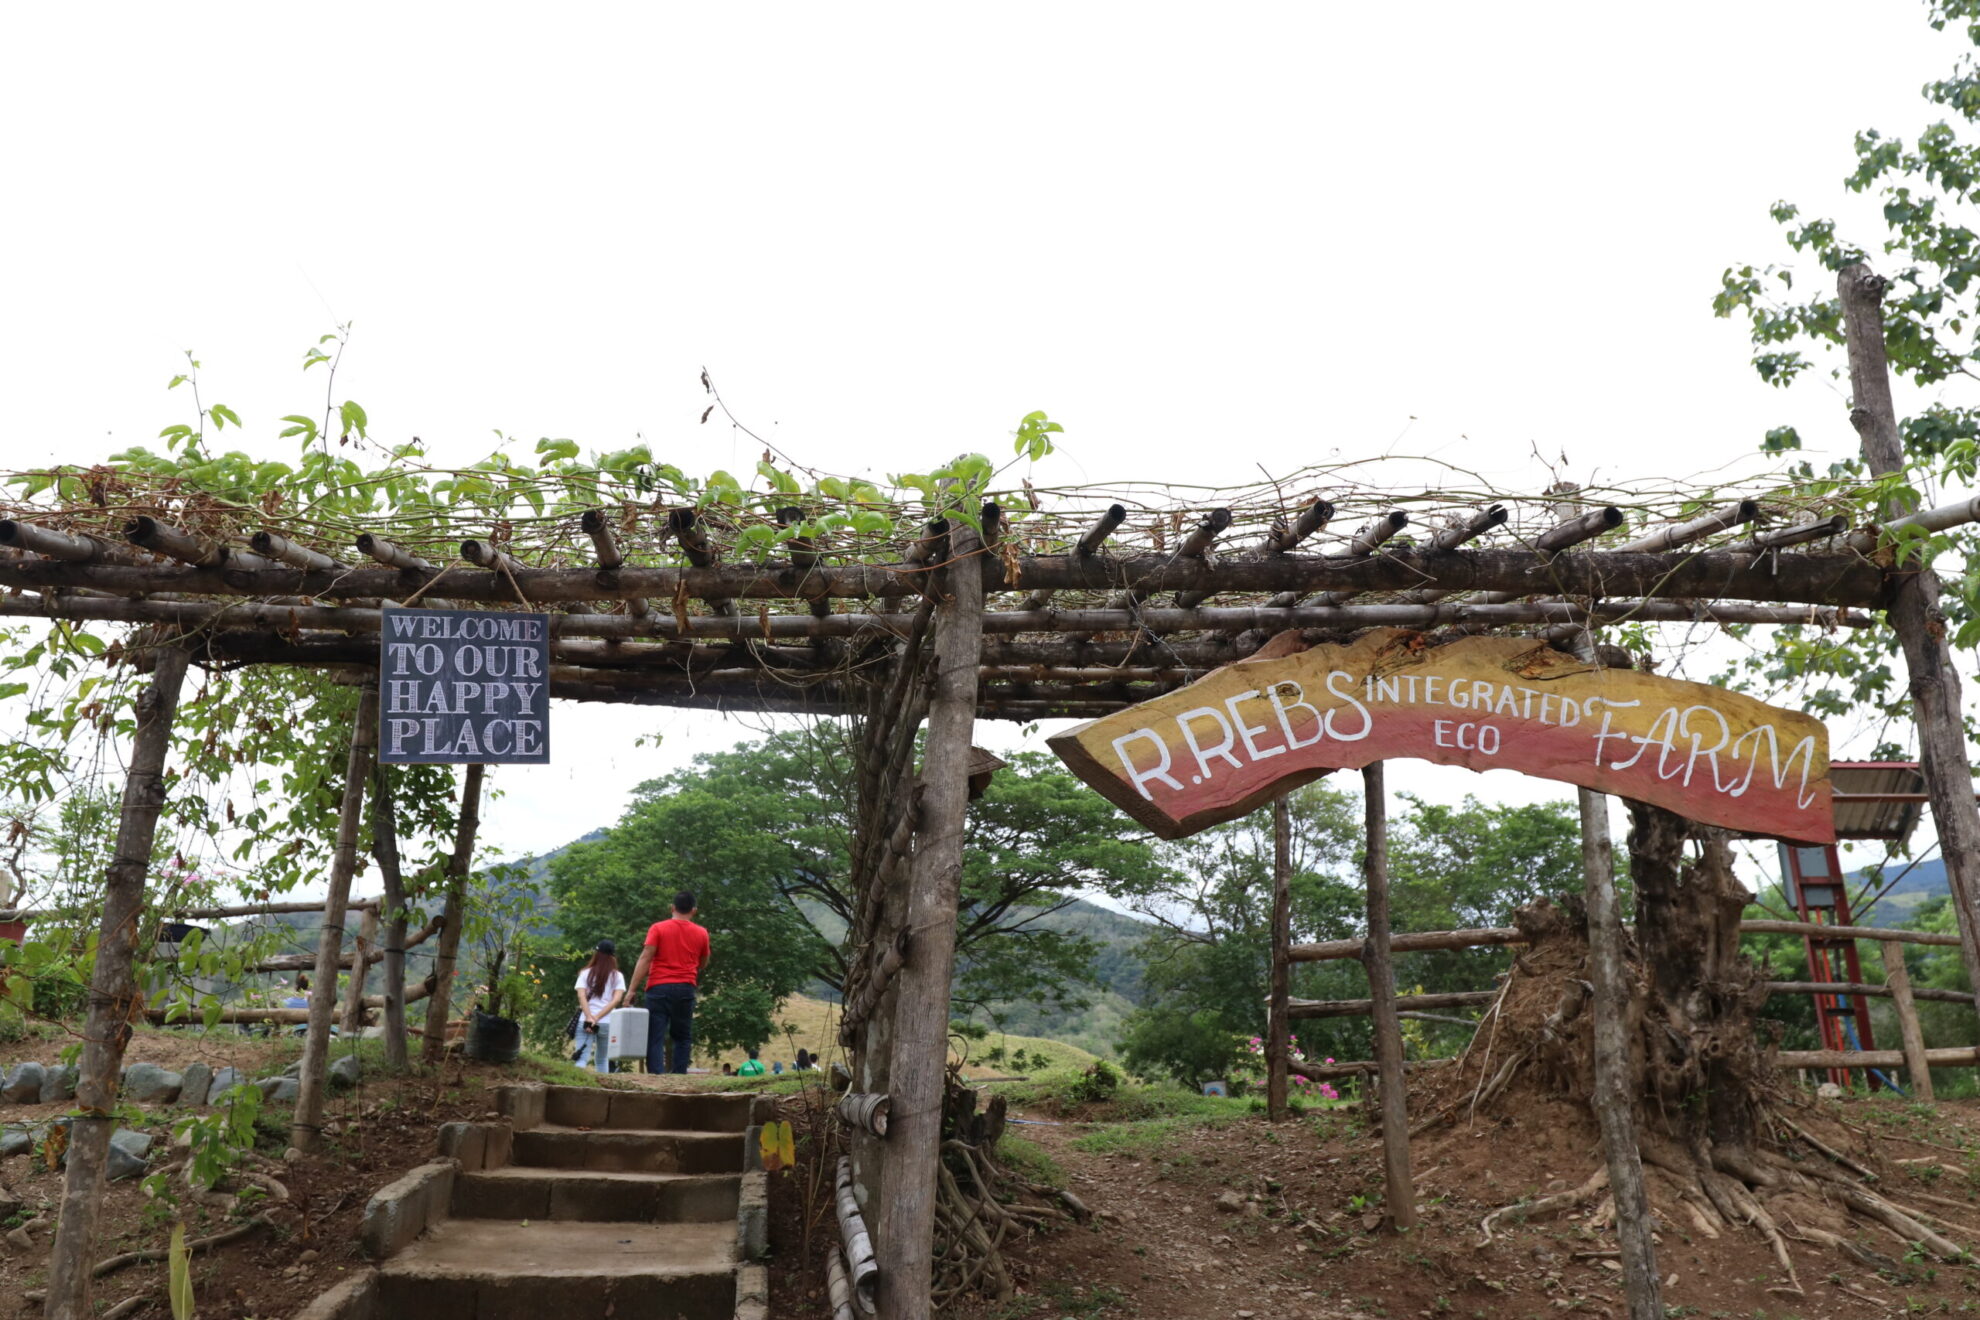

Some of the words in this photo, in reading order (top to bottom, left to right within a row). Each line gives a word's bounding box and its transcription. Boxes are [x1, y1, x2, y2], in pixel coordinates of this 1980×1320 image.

[389, 615, 542, 641] WELCOME
[388, 643, 444, 676] TO
[454, 644, 542, 678] OUR
[387, 680, 543, 714] HAPPY
[387, 718, 543, 755] PLACE
[1366, 675, 1581, 727] INTEGRATED
[1583, 697, 1816, 809] FARM
[1434, 719, 1500, 755] ECO
